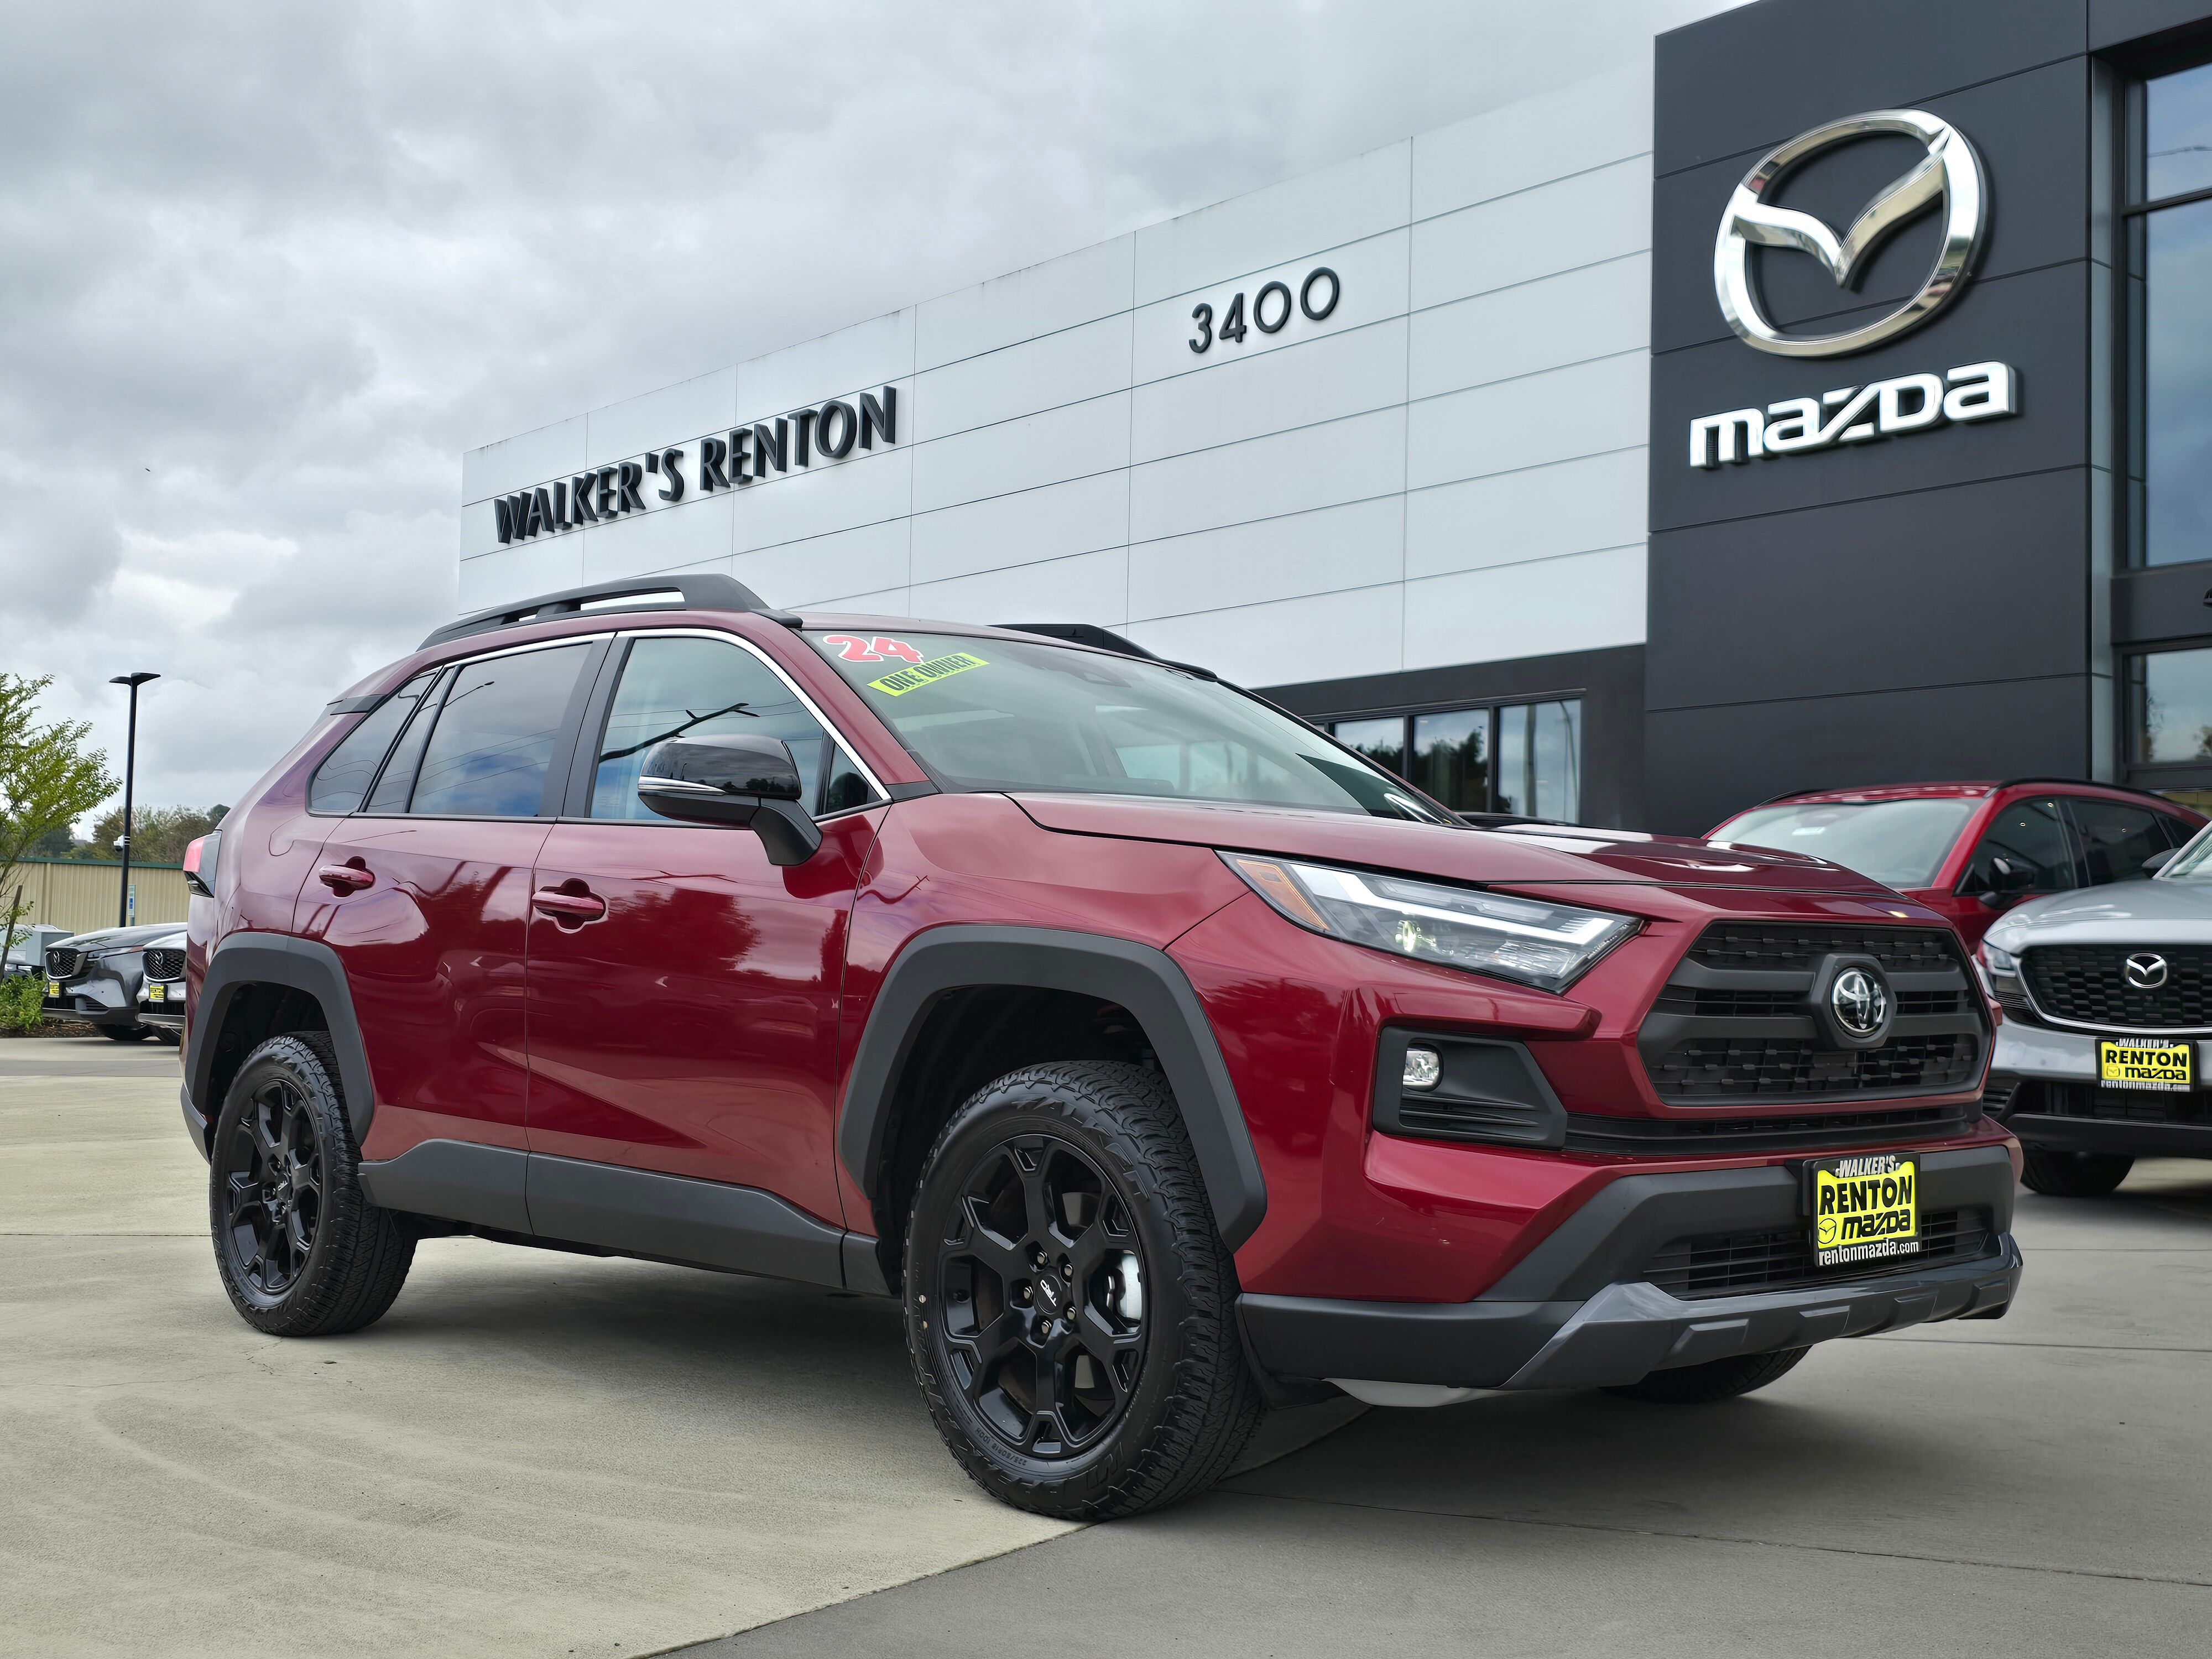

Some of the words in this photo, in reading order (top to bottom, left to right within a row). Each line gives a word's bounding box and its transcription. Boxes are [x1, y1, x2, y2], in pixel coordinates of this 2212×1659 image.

[1189, 267, 1340, 353] 3400
[1689, 361, 2017, 467] mazda
[494, 448, 684, 544] WALKER'S
[700, 385, 897, 492] RENTON
[823, 635, 924, 664] 24
[879, 670, 927, 691] ONE
[912, 655, 978, 679] OWNER
[2105, 1049, 2187, 1067] RENTON
[2125, 1067, 2187, 1080] mazda
[1839, 1155, 1896, 1178] WALKER'S
[1819, 1175, 1912, 1215] RENTON
[1840, 1209, 1911, 1240] mazda
[1818, 1238, 1919, 1266] rentonmazda.com
